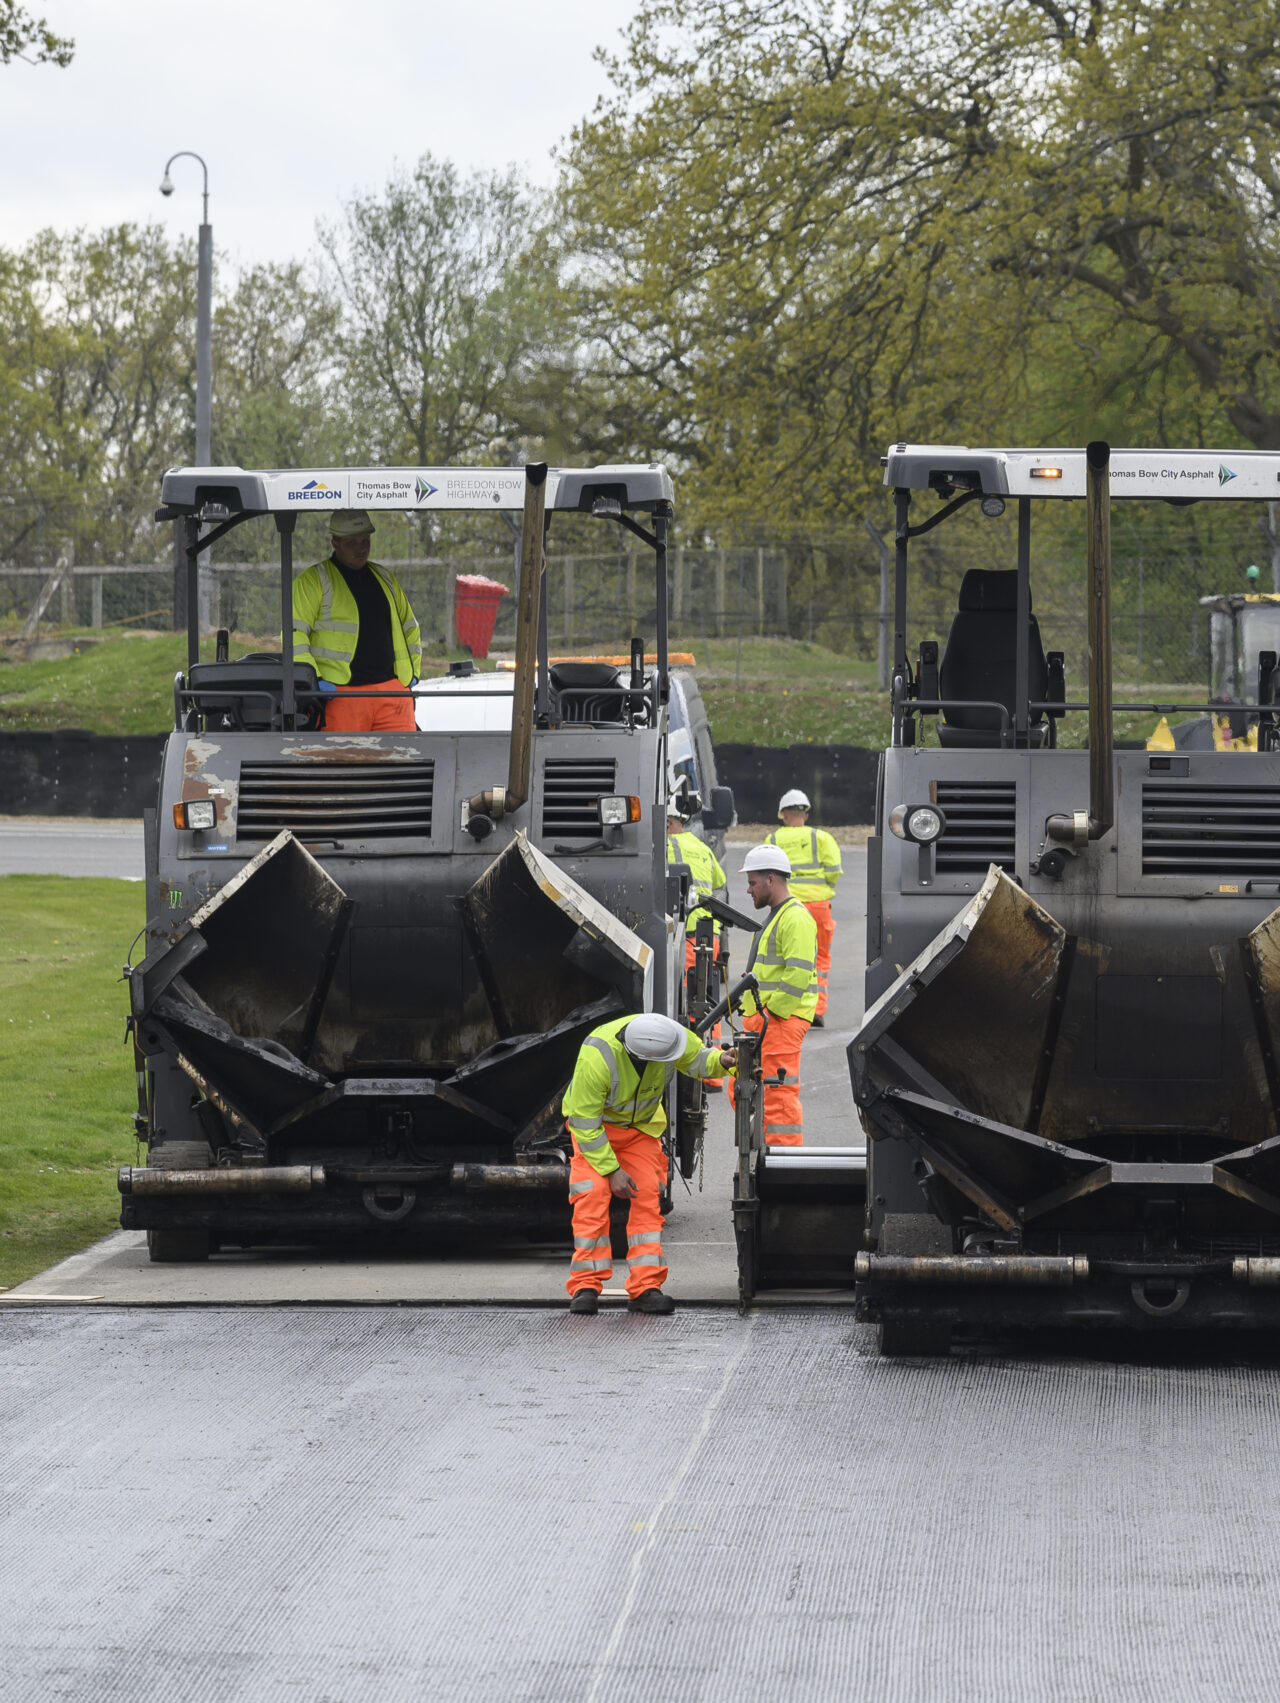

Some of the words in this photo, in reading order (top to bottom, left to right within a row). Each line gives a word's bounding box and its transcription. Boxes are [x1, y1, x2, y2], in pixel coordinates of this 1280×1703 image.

[1138, 469, 1158, 478] Bow
[1161, 469, 1178, 480] City
[1180, 470, 1214, 480] Asphalt
[356, 482, 391, 490] Thomas
[447, 480, 496, 489] BREEDON
[498, 480, 522, 489] BOW
[288, 491, 342, 500] BREEDON
[356, 491, 374, 500] City
[376, 491, 408, 500] Asphalt
